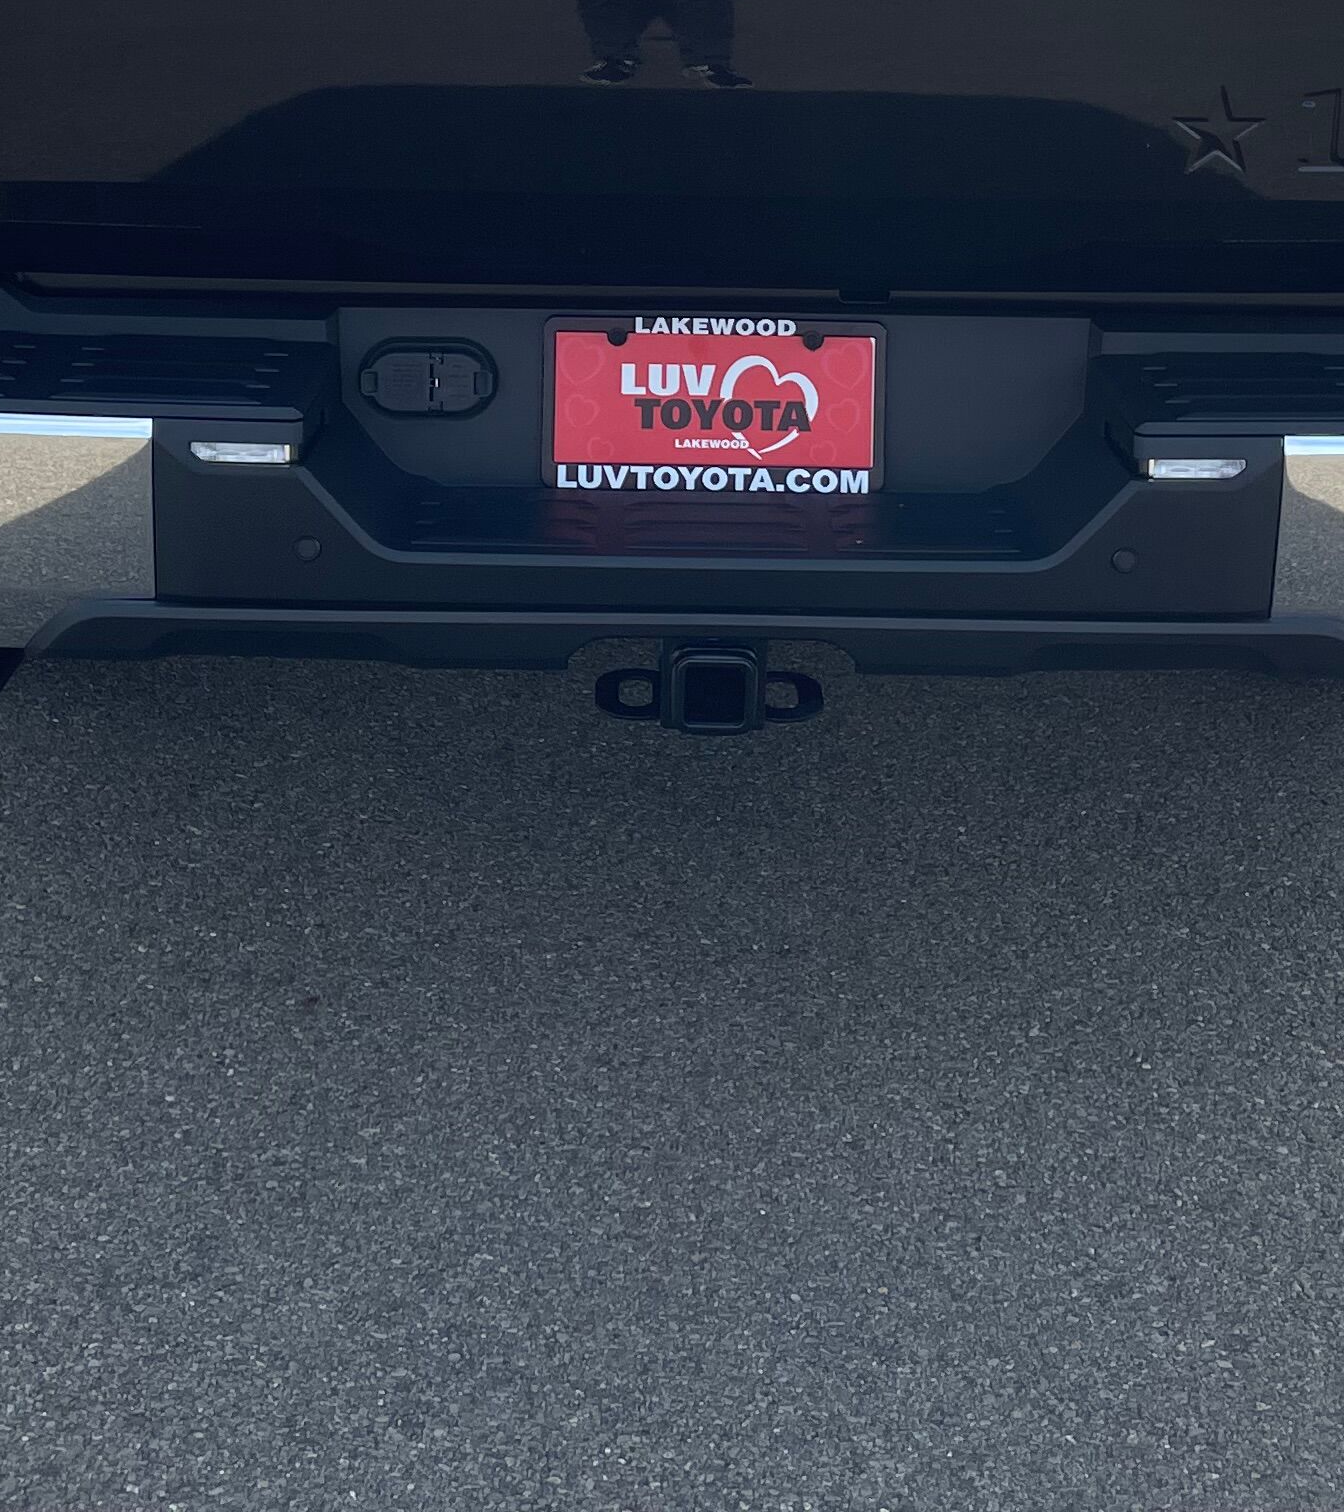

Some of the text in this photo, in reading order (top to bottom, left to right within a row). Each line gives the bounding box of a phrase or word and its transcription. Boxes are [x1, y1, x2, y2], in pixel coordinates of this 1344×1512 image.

[634, 316, 797, 336] LAKEWOOD
[620, 363, 716, 397] LUV
[634, 398, 812, 432] TOYOTA
[674, 438, 750, 450] LAKEWOOD
[557, 464, 870, 494] LUVTOYOTA.COM
